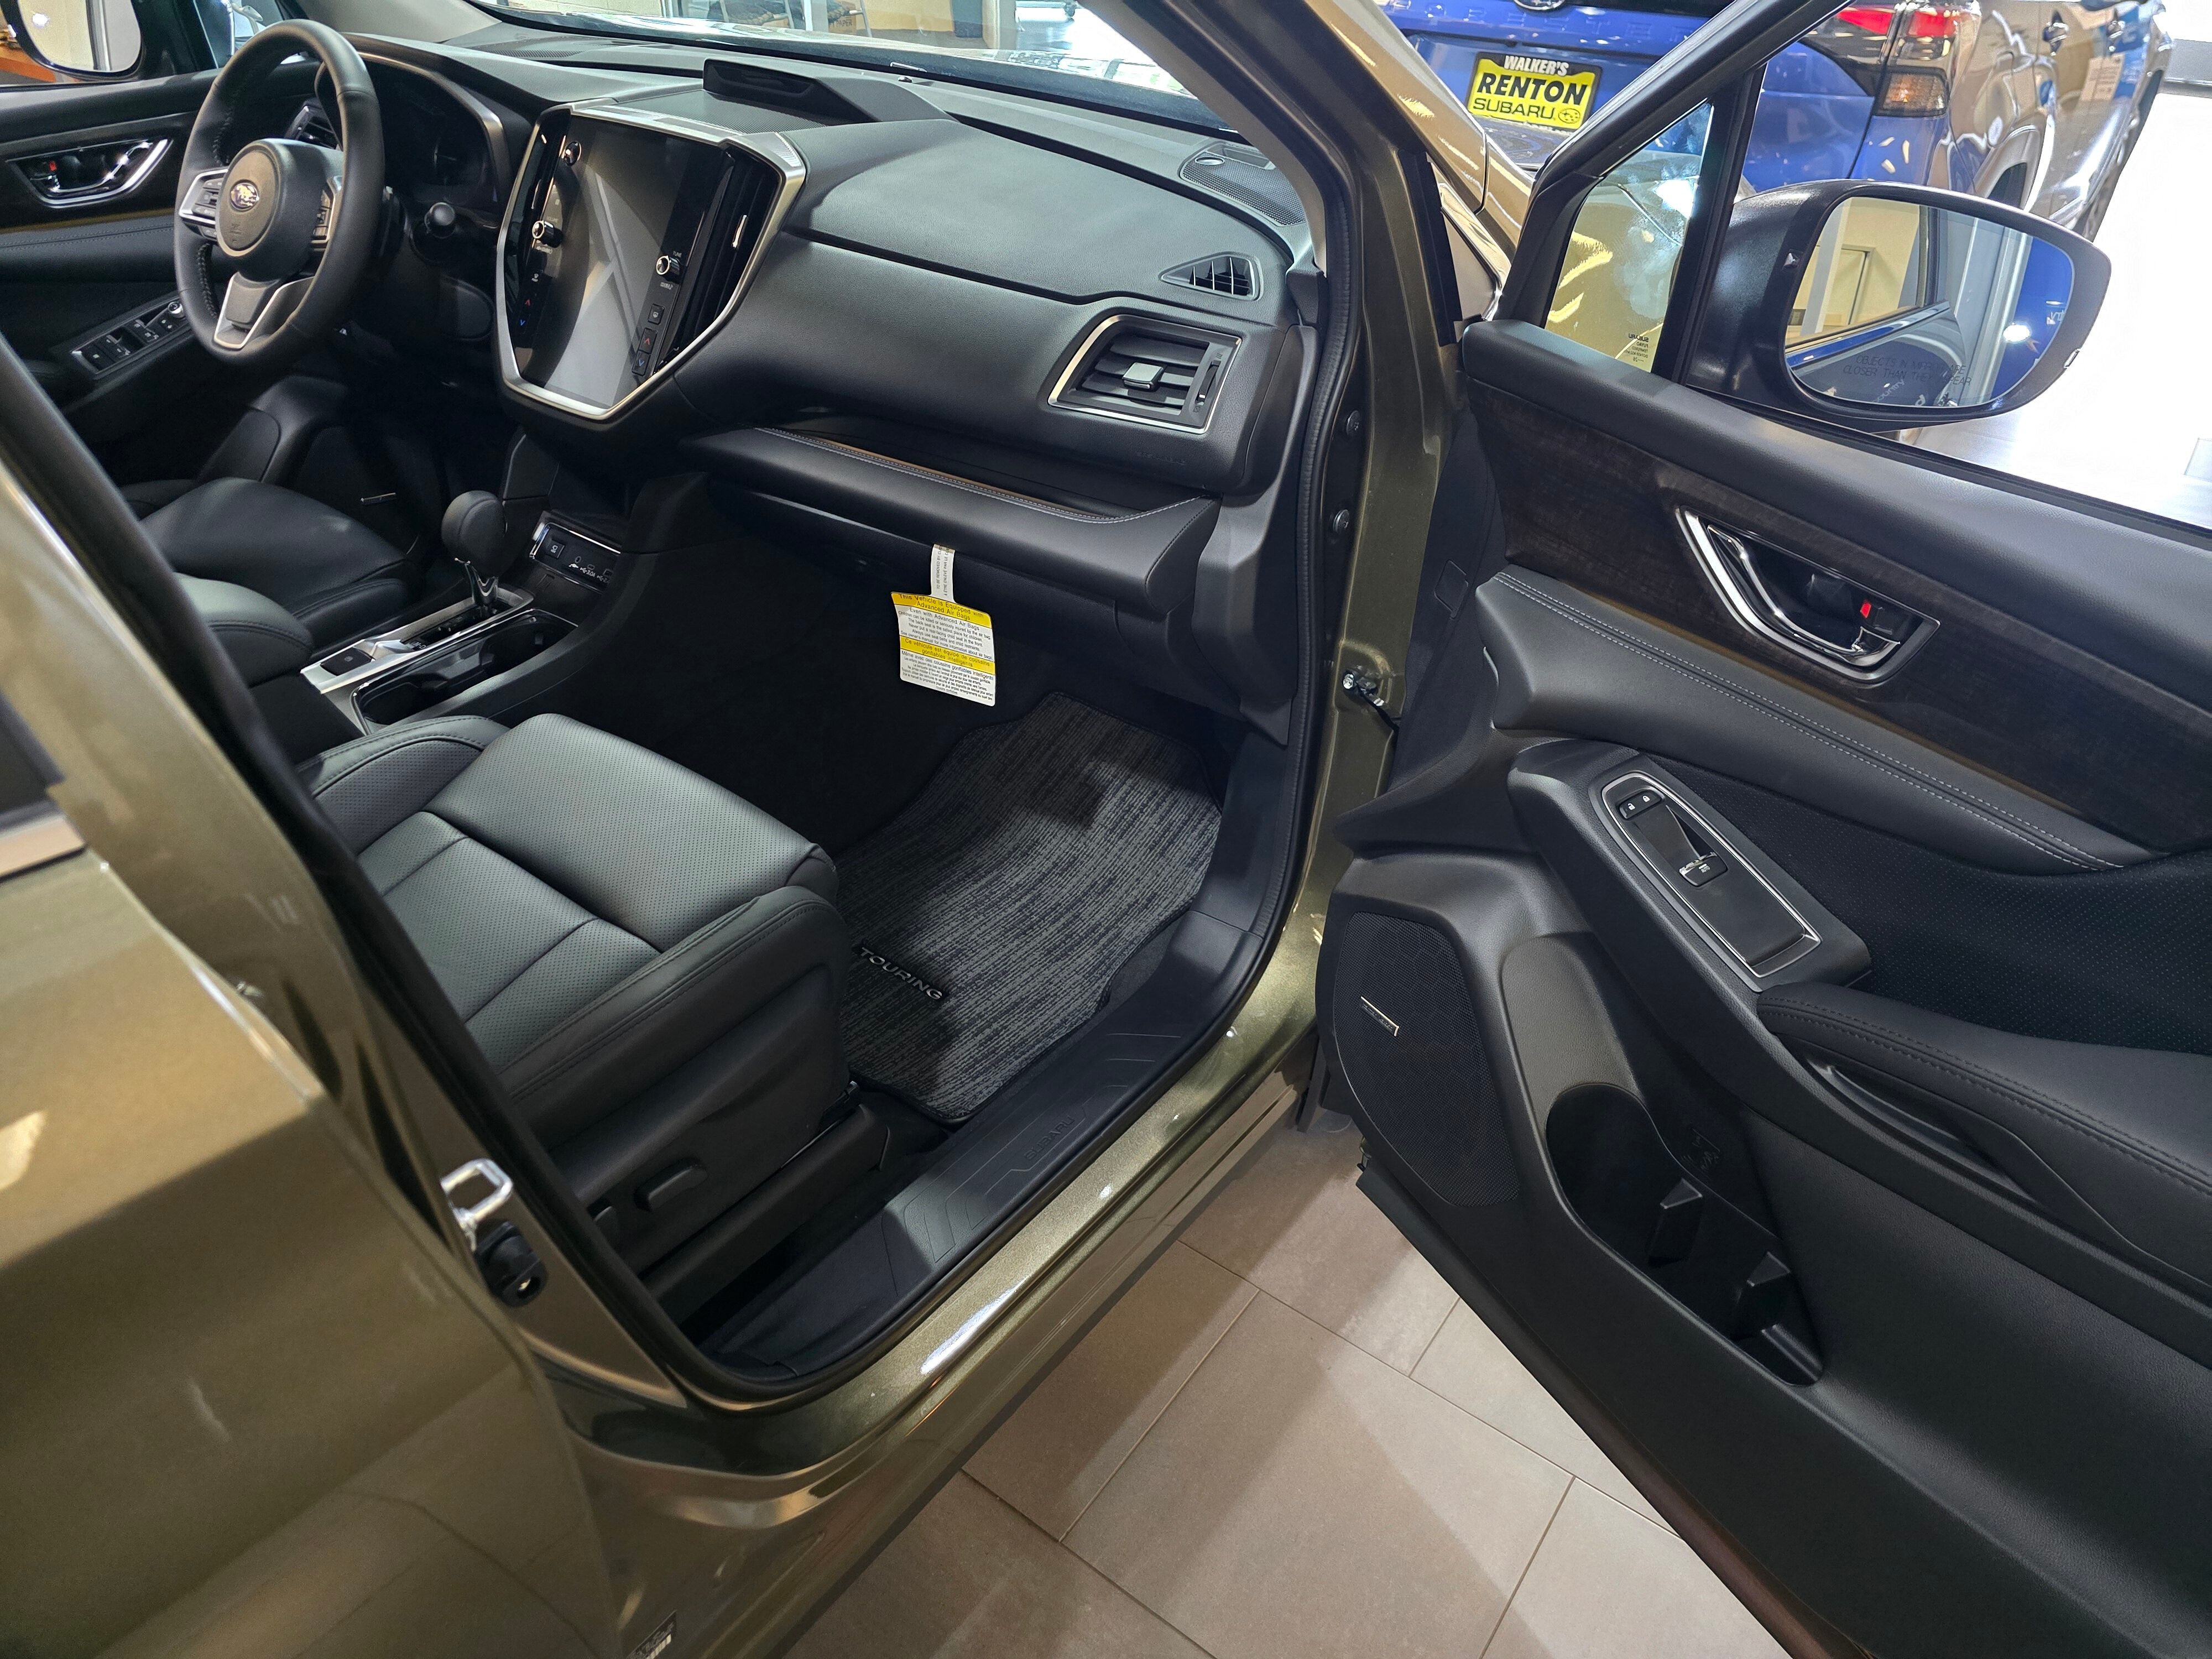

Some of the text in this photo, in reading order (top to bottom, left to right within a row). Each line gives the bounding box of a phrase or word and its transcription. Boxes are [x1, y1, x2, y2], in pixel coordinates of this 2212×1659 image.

[1504, 55, 1569, 76] WALKER'S
[1477, 72, 1588, 105] RENTON
[1473, 98, 1556, 119] SUBARU
[1856, 355, 1895, 367] OBJECTS
[1843, 365, 1877, 377] CLOSER
[1883, 369, 1907, 379] THAN
[914, 595, 936, 604] Vehicle
[945, 602, 971, 614] Equipped
[917, 601, 945, 613] Advanced
[957, 612, 971, 620] Bags
[935, 614, 957, 624] Advanced
[914, 641, 933, 650] véhicule
[943, 649, 959, 658] équipé
[969, 657, 990, 667] coussins
[922, 649, 973, 667] gonflables intelligents
[860, 946, 942, 1000] TOURING
[1024, 1115, 1074, 1160] SUBARU
